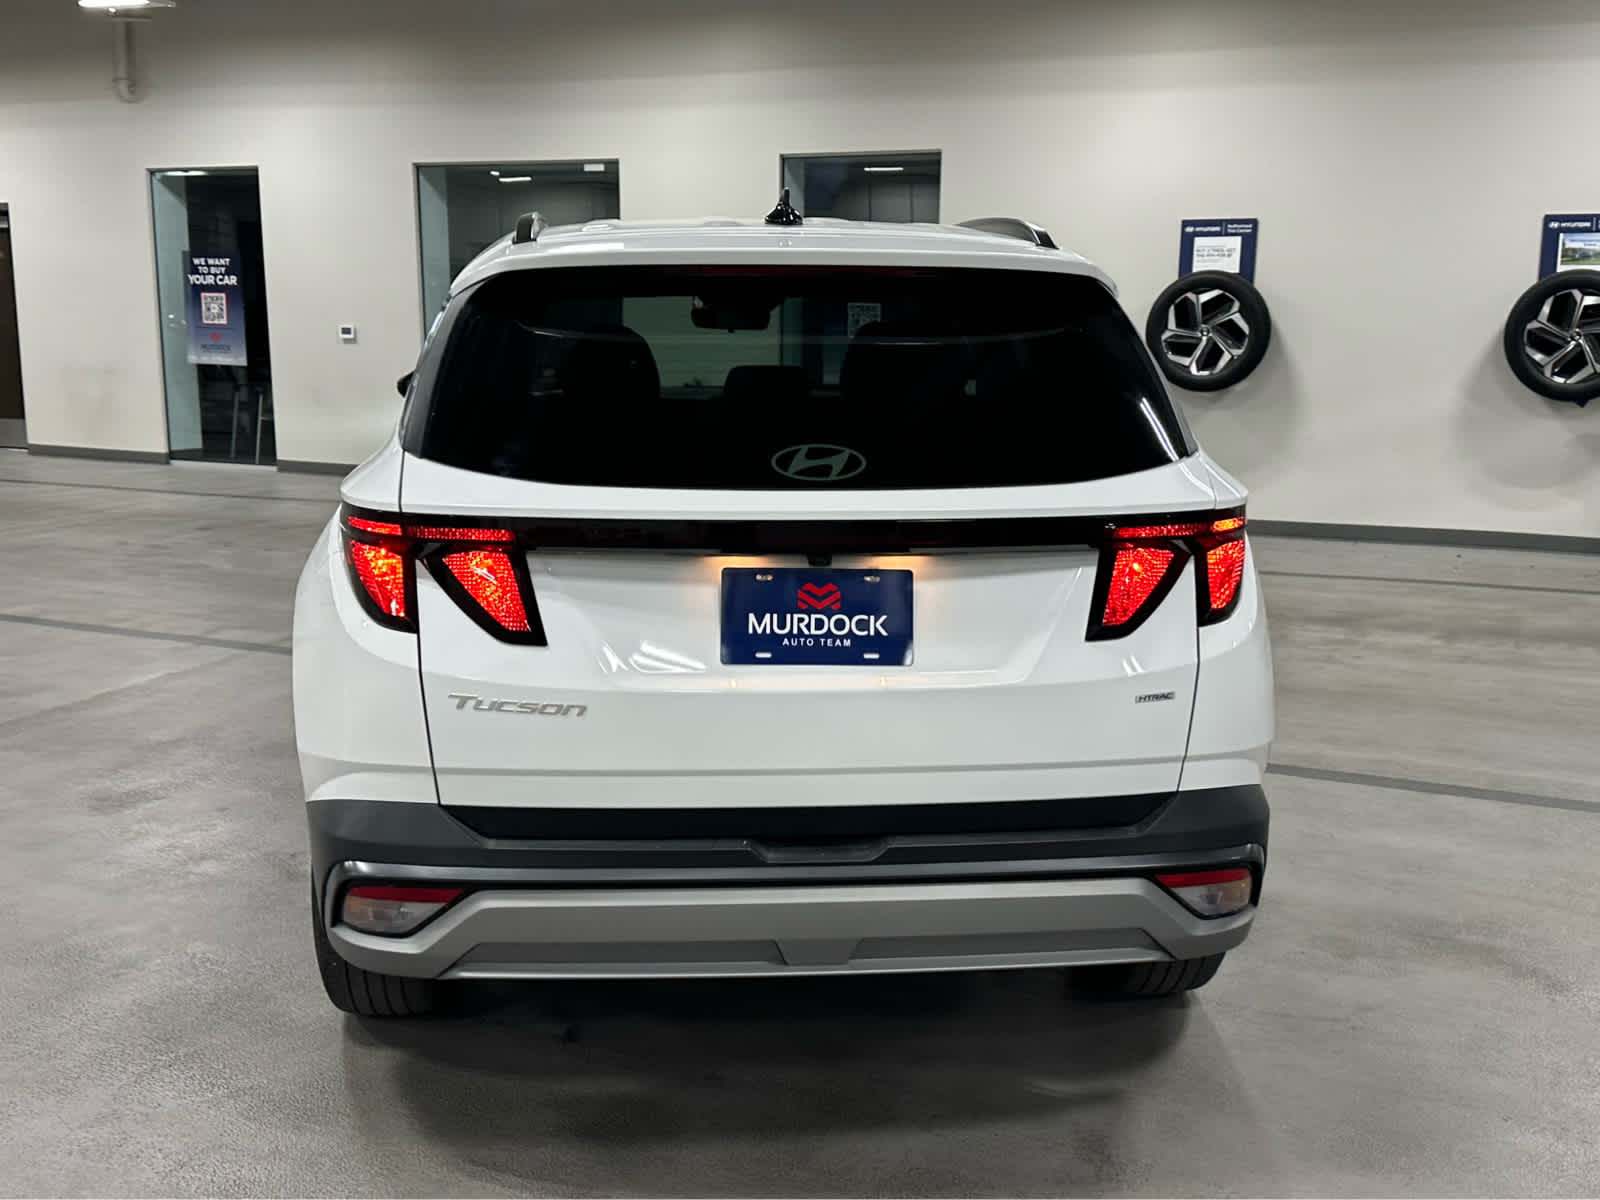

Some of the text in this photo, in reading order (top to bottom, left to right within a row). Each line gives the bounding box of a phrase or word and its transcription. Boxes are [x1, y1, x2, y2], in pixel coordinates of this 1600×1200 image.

[192, 257, 231, 266] WE WANT
[198, 266, 226, 274] TO BUY
[187, 274, 238, 286] YOUR CAR
[748, 612, 888, 636] MURDOCK
[782, 637, 851, 647] AUTO TEAM
